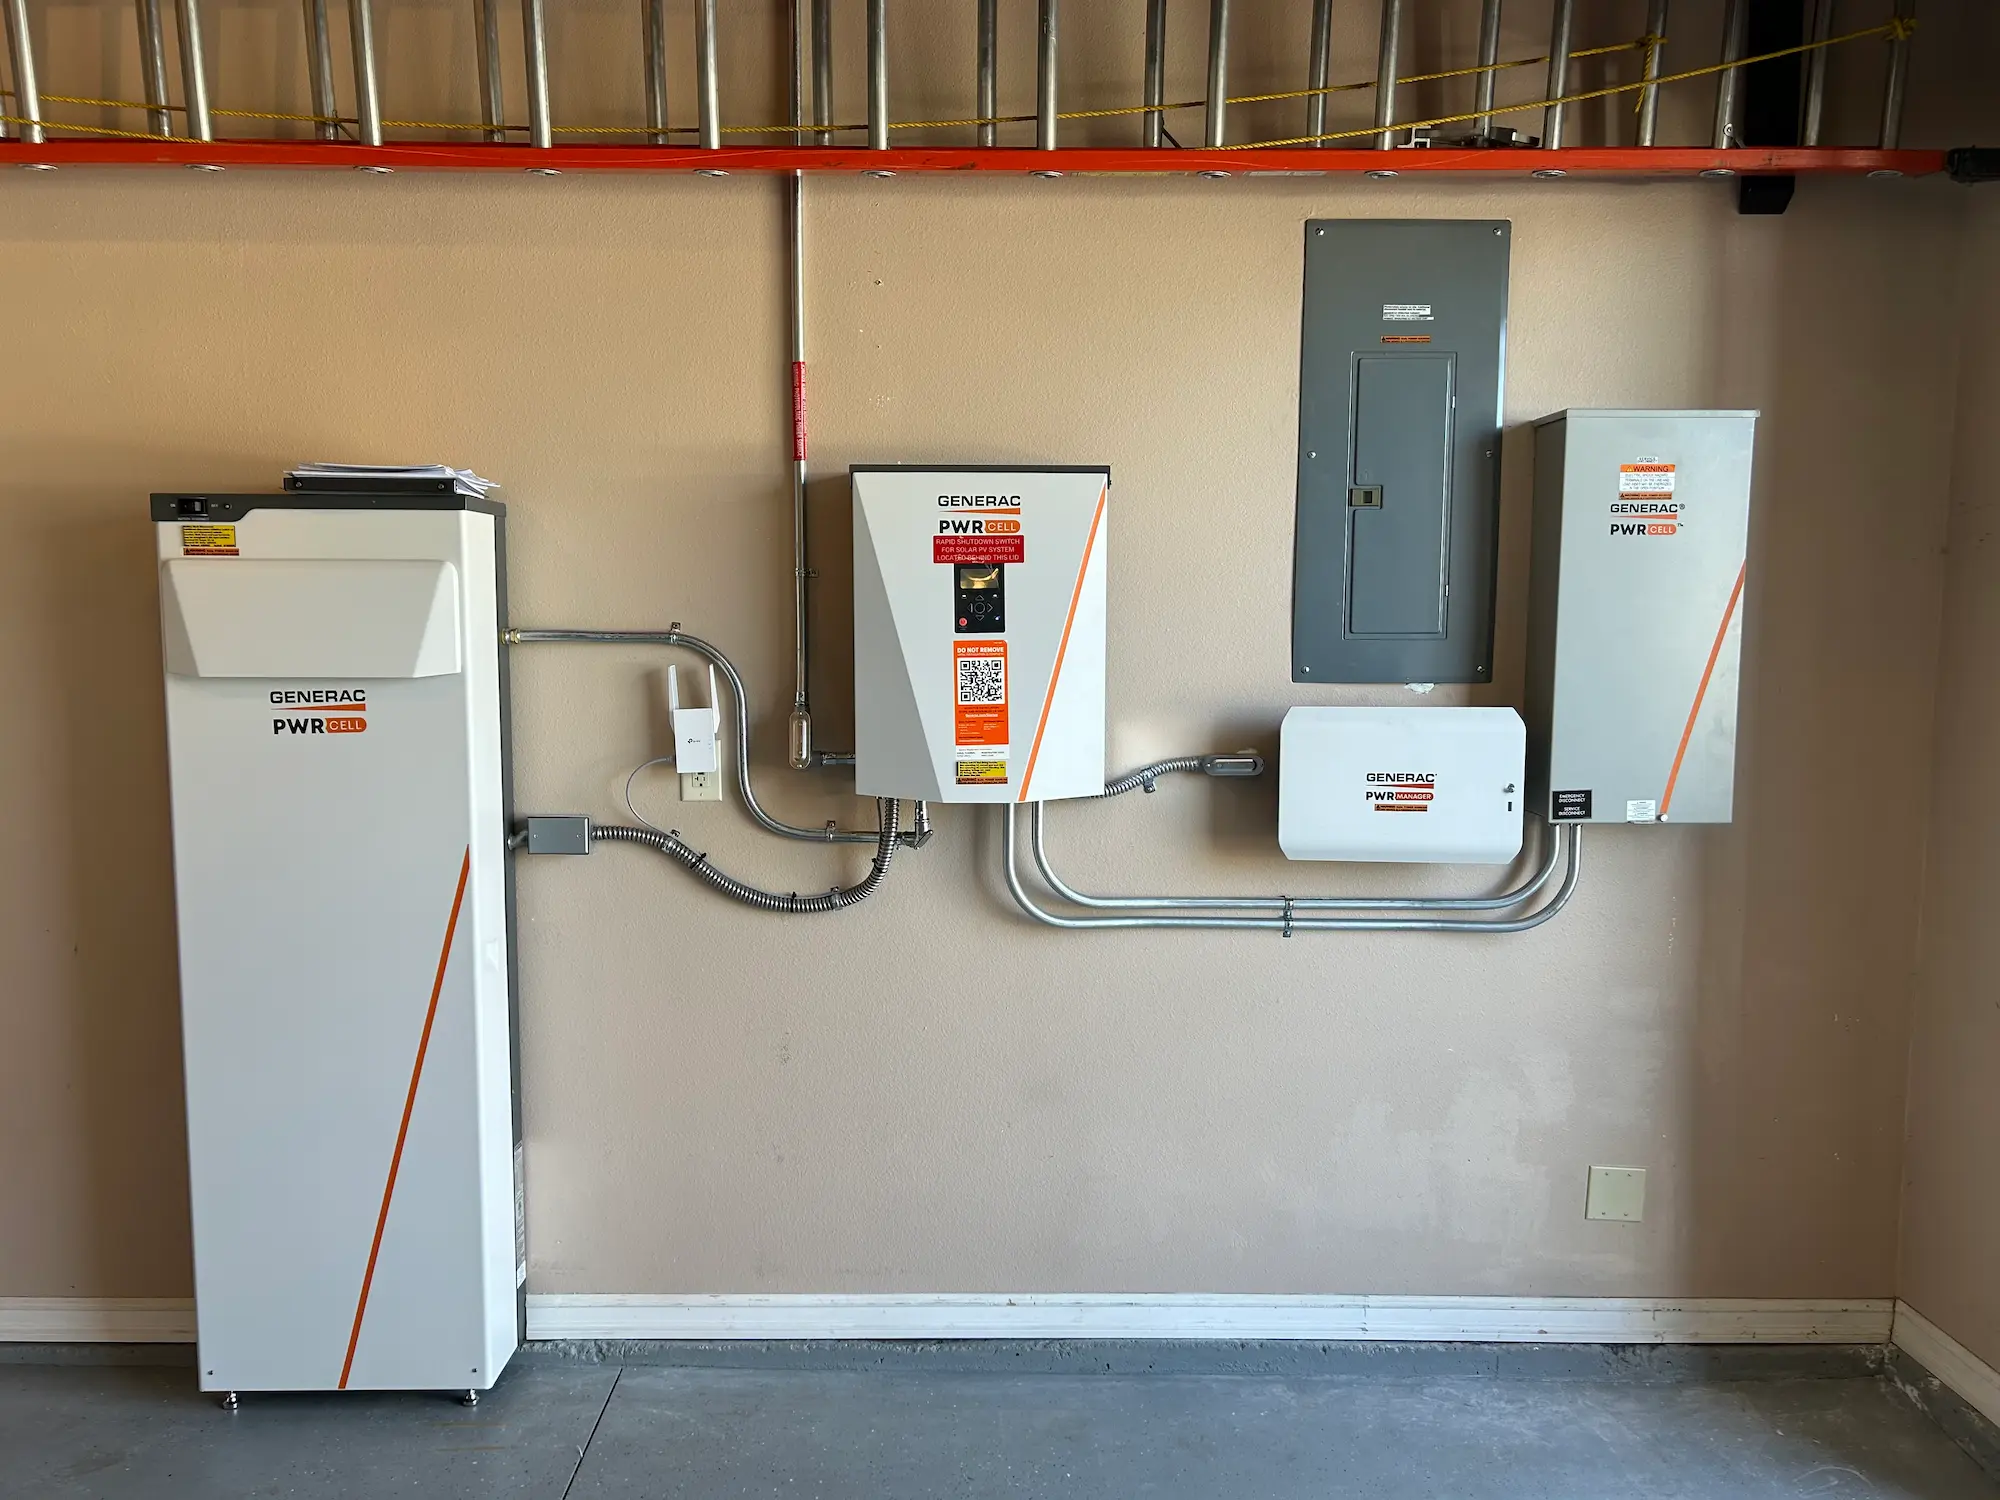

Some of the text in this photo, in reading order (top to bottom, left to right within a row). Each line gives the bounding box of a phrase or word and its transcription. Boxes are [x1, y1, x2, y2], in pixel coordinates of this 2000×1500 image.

[938, 495, 1021, 507] GENERAC
[269, 690, 366, 704] GENERAC
[1366, 773, 1435, 782] GENERAC
